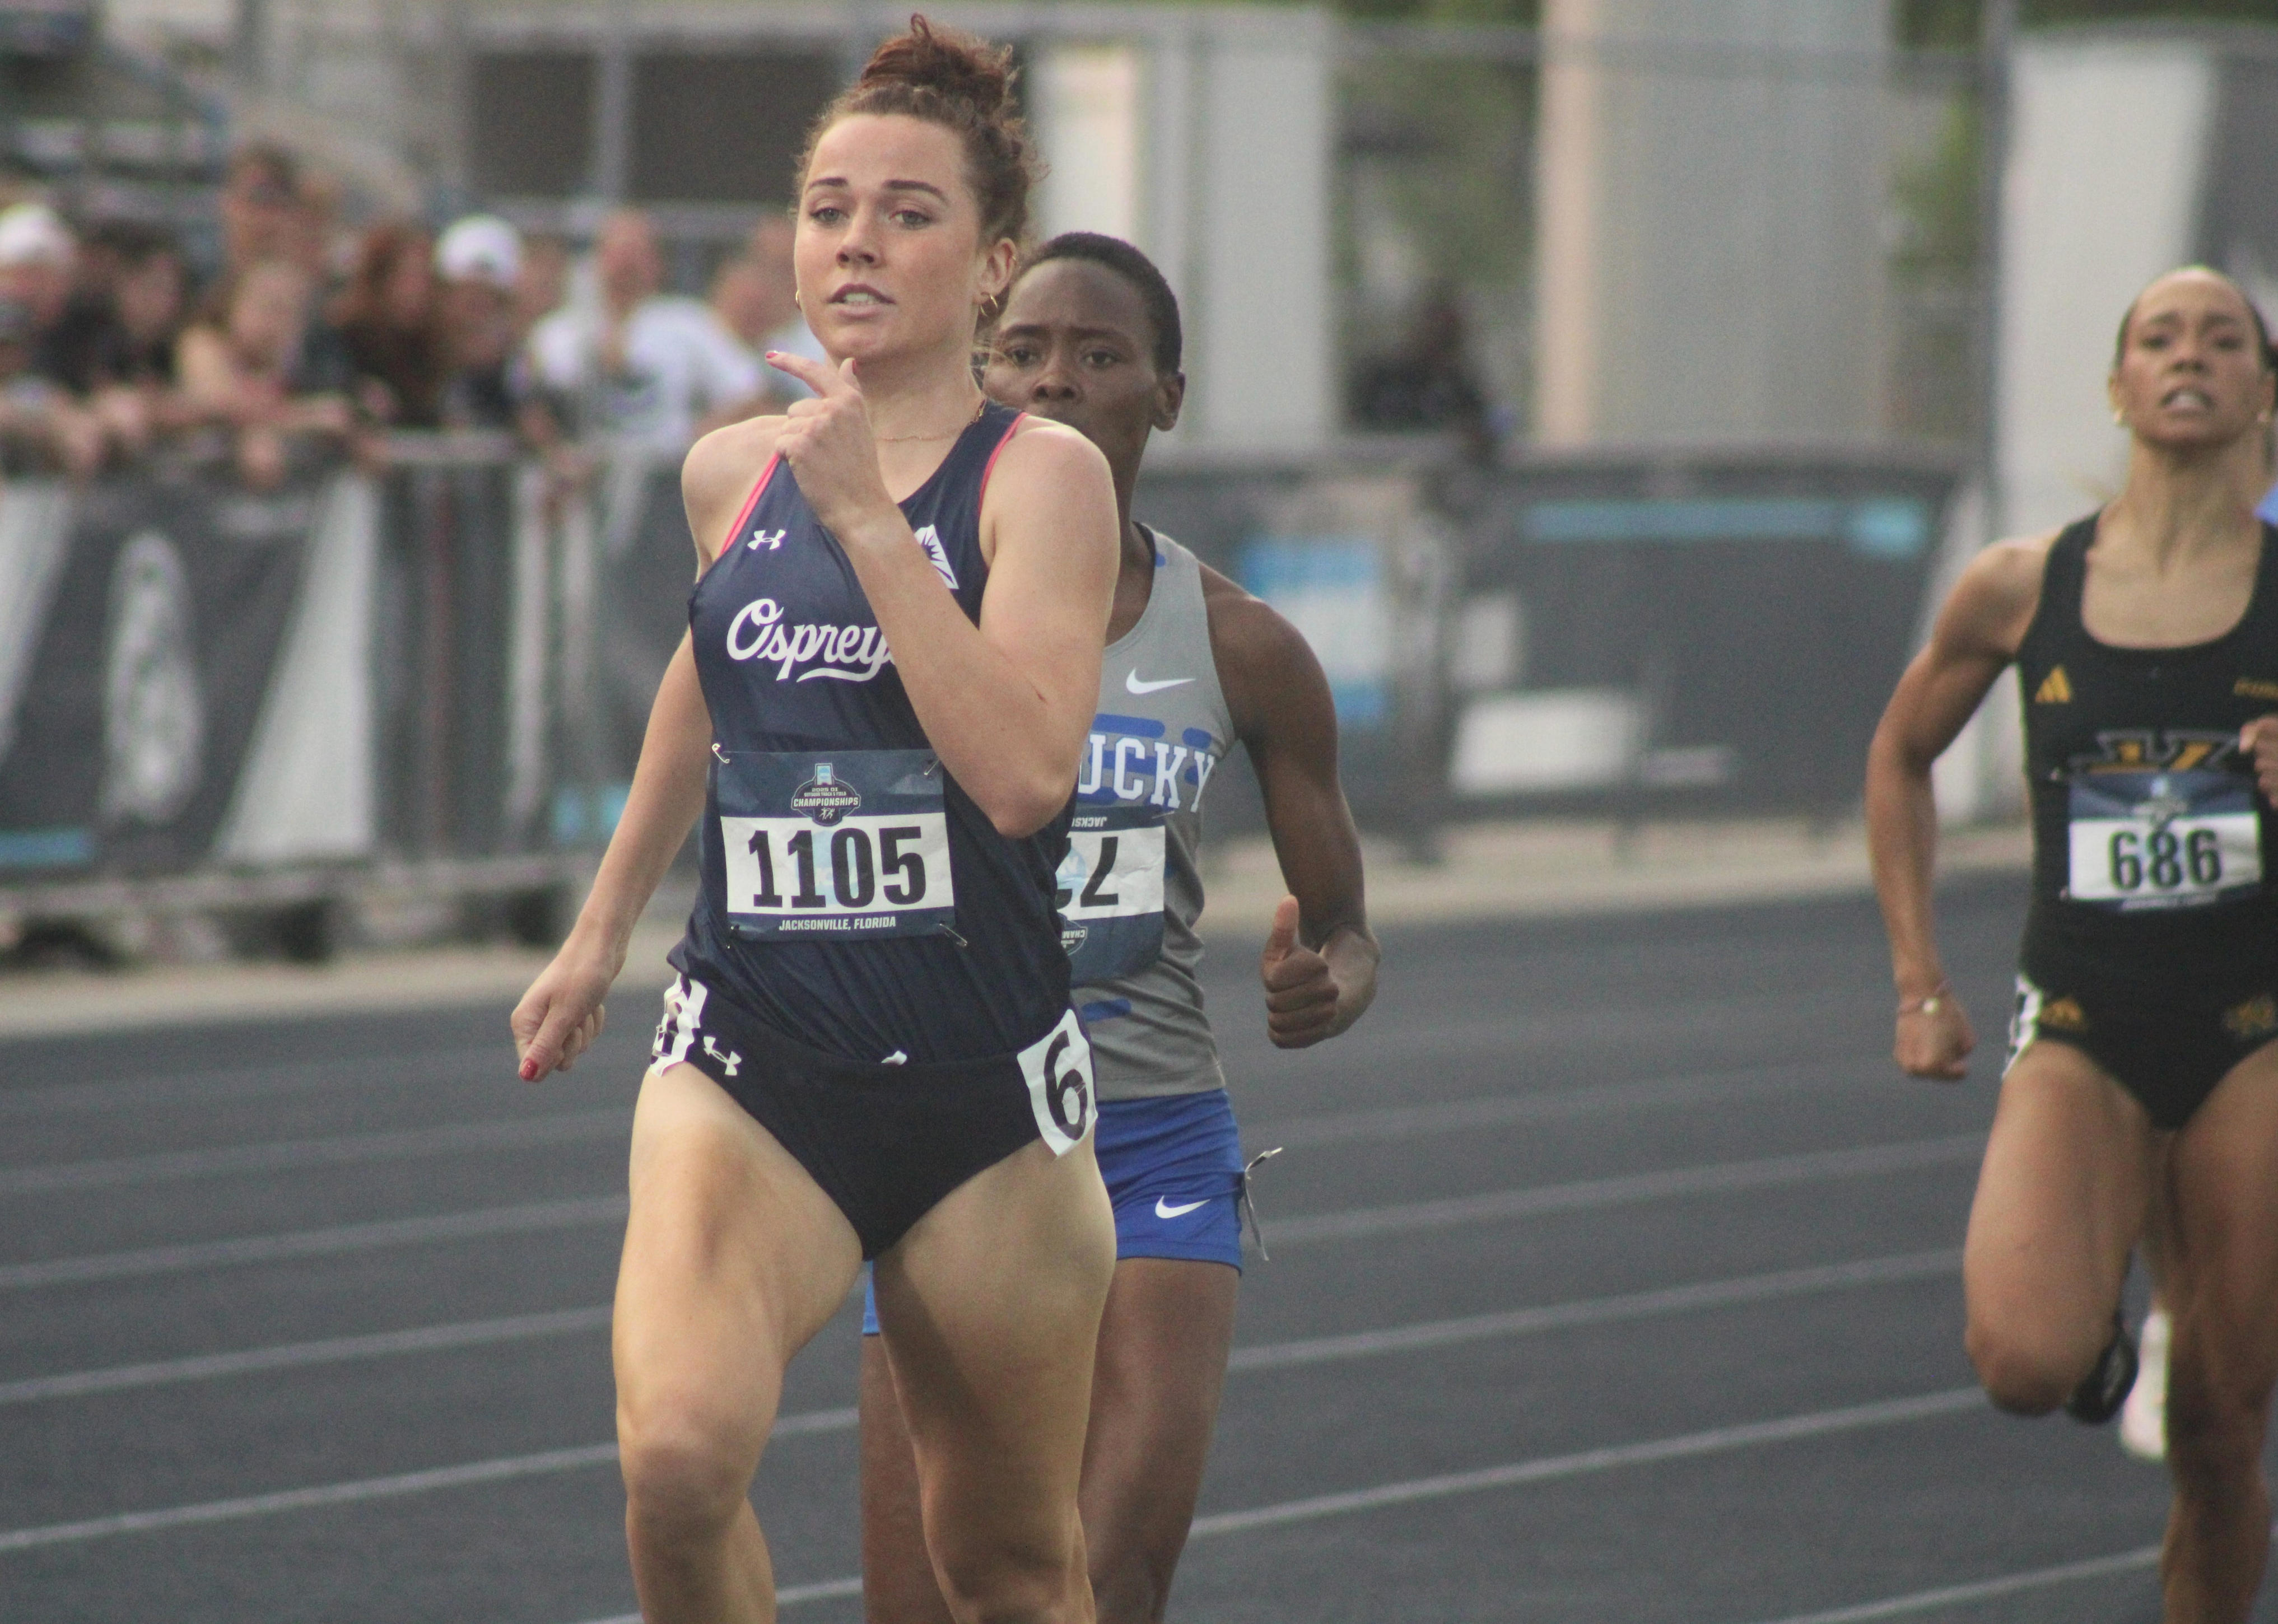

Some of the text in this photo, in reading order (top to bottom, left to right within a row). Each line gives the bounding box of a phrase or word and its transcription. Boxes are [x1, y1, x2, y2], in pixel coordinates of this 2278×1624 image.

[793, 797, 859, 807] CHAMPIONSHIPS
[1072, 816, 1107, 827] JACKS
[748, 826, 926, 908] 1105
[2108, 828, 2222, 892] 686
[779, 916, 896, 931] JACKSONVILLE, FLORIDA
[1061, 929, 1085, 939] CHAM
[1043, 1029, 1088, 1141] 6
